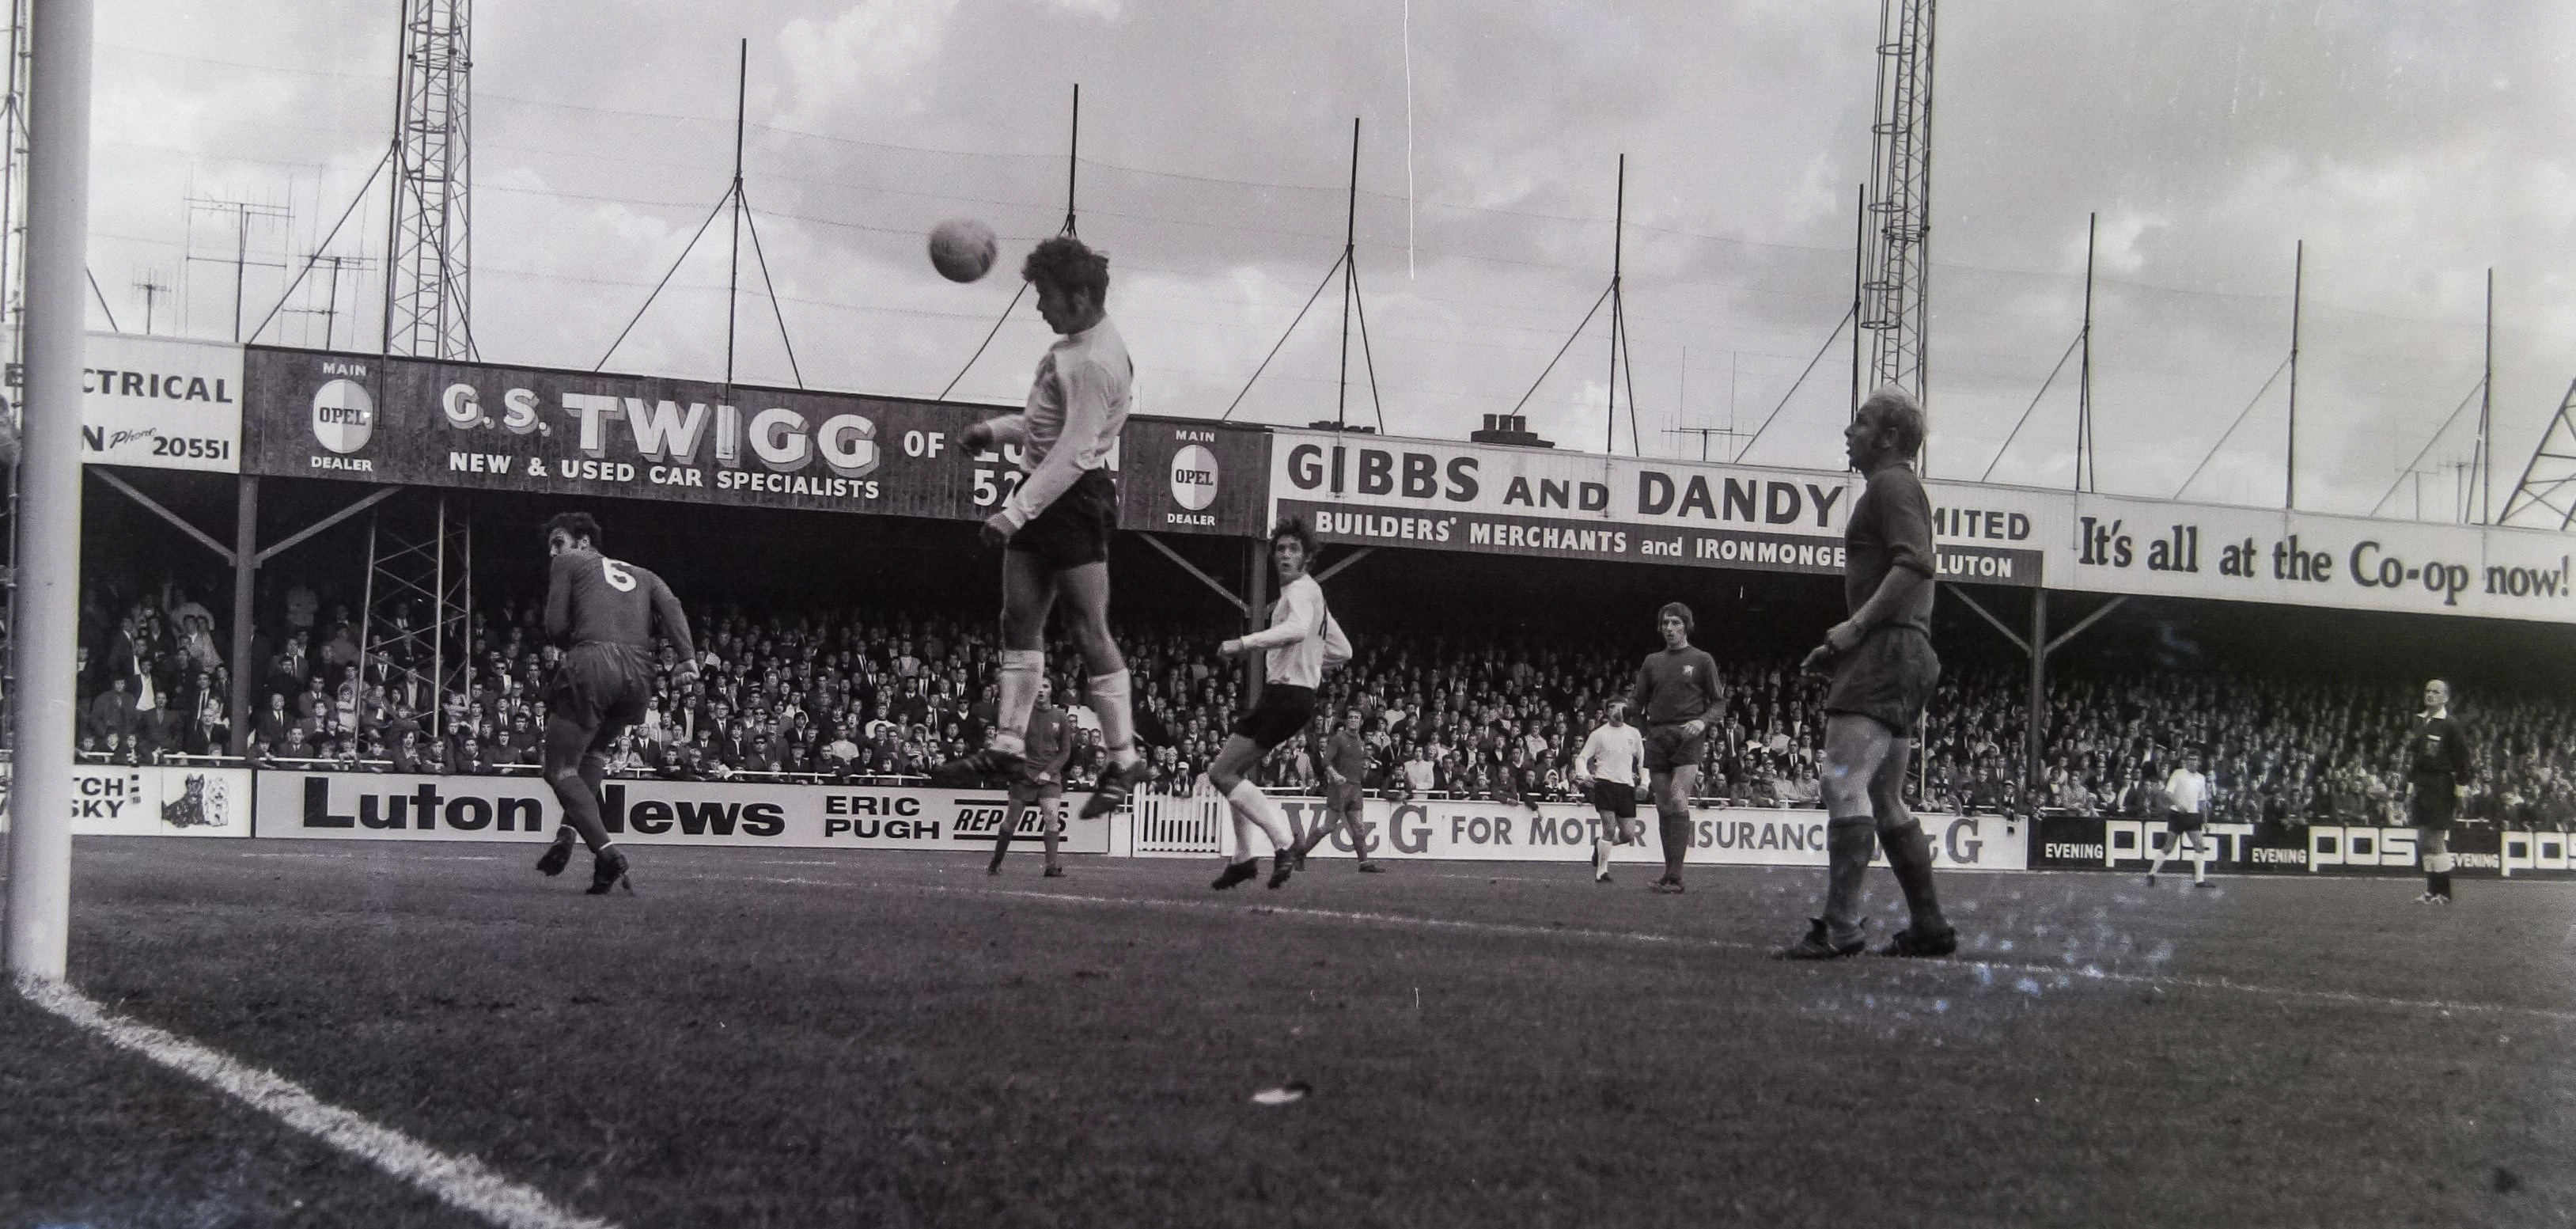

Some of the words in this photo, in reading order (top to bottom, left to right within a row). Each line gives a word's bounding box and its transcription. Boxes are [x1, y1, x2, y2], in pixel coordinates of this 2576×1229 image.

[322, 362, 367, 377] MAIN
[320, 407, 366, 426] OPEL
[110, 427, 157, 449] Phone
[153, 436, 229, 460] 20551
[563, 393, 879, 477] TWIGG
[904, 431, 945, 457] OF
[1175, 430, 1215, 442] MAIN
[311, 456, 373, 472] DEALER
[449, 452, 512, 474] NEW
[528, 457, 548, 476] &
[562, 460, 635, 483] USED
[650, 465, 703, 487] CAR
[717, 470, 879, 499] SPECIALISTS
[1175, 469, 1214, 486] OPEL
[1288, 444, 1479, 502] GIBBS
[1503, 476, 1610, 512] AND
[1637, 470, 1844, 528] DANDY
[1167, 513, 1216, 526] DEALER
[1469, 522, 1627, 554] MERCHANTS
[1641, 537, 1683, 557] and
[1936, 553, 2013, 578] LUTON
[2078, 516, 2133, 568] It's
[2147, 525, 2199, 573] all
[2218, 537, 2257, 578] at
[2273, 534, 2332, 582] the
[2349, 541, 2470, 606] Co-op
[2485, 555, 2570, 597] now!
[601, 556, 636, 592] 6
[304, 776, 542, 833] Luton
[826, 795, 920, 817] ERIC
[824, 819, 941, 840] PUGH
[953, 808, 1068, 832] REPRTS
[1452, 816, 1513, 845] FOR
[1529, 817, 1646, 848] MOTR
[2045, 842, 2104, 859] EVENING
[2252, 847, 2307, 864] EVENING
